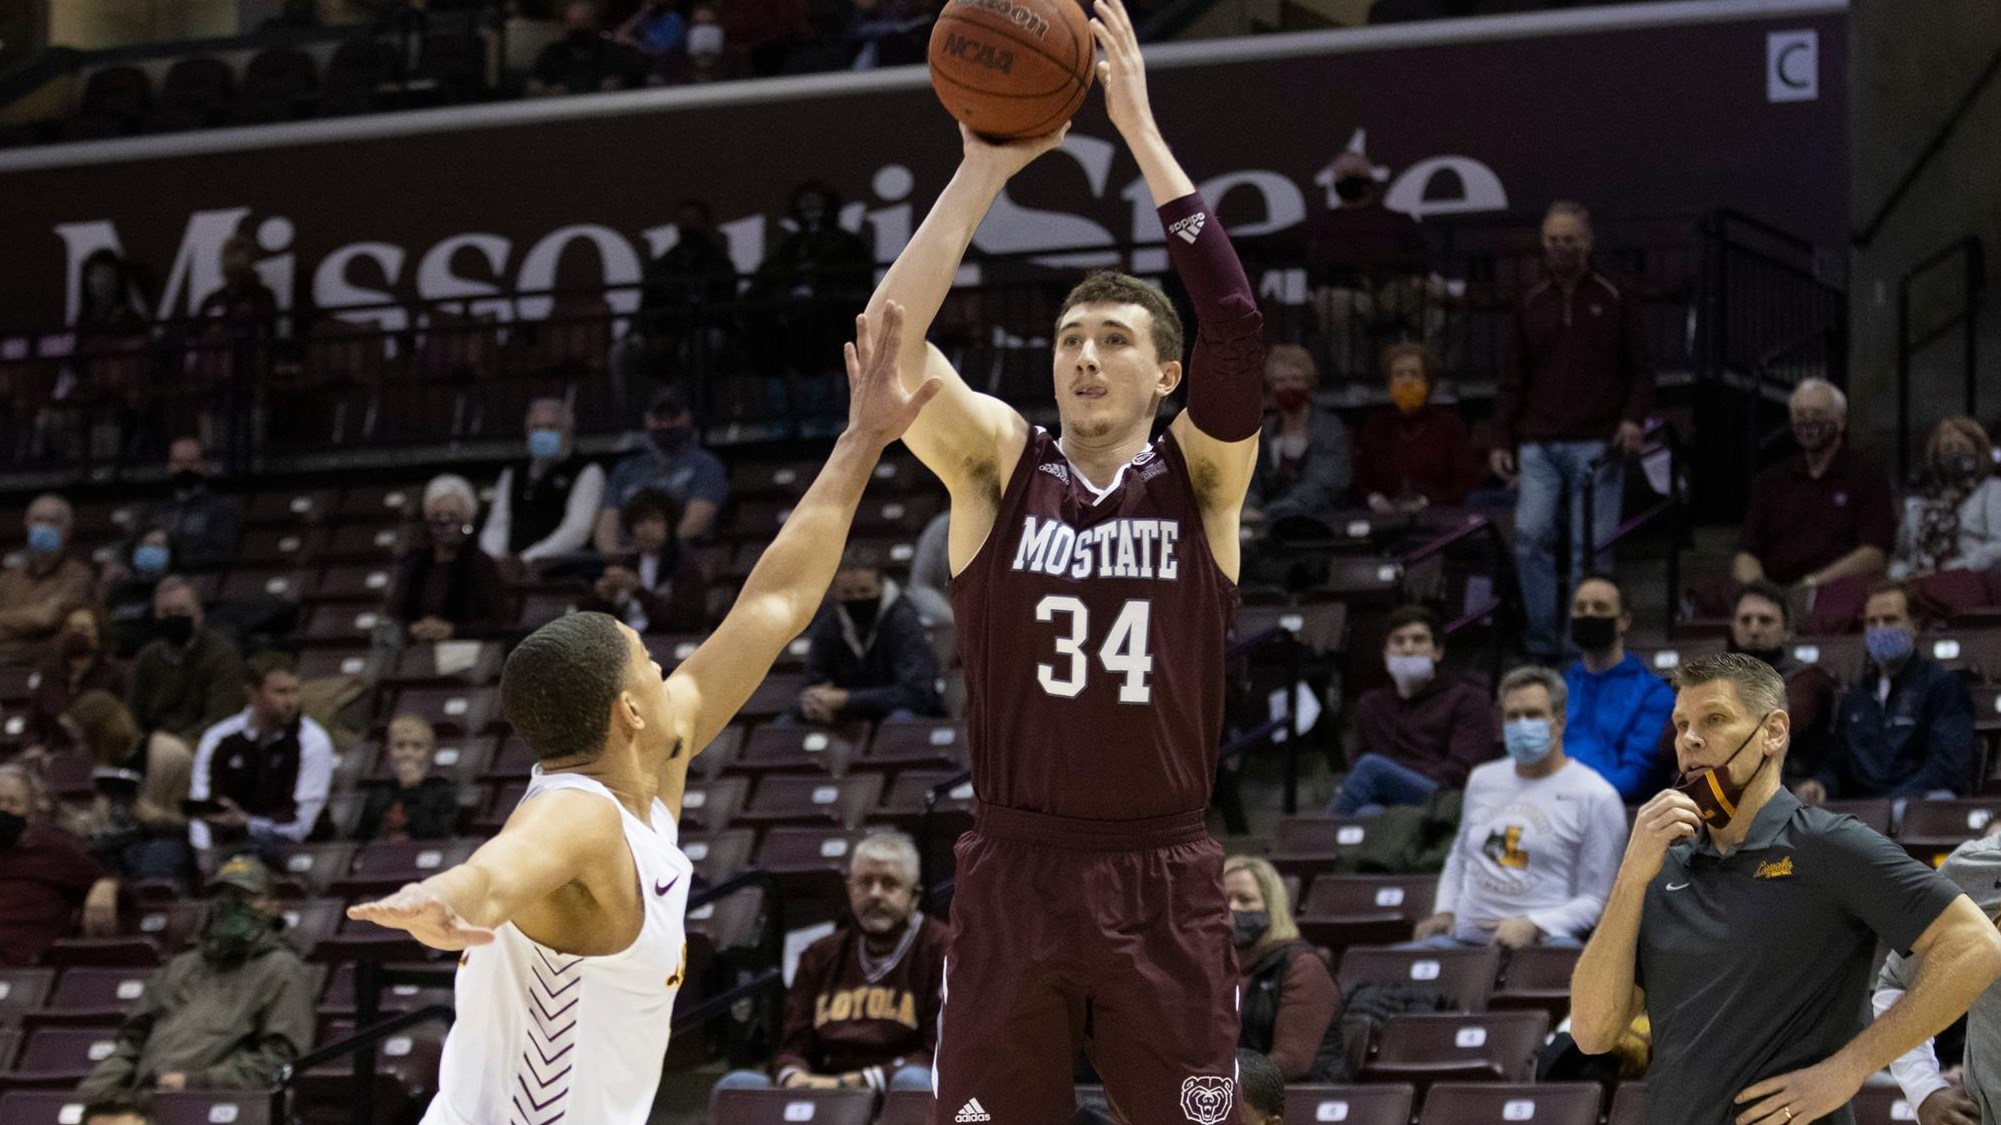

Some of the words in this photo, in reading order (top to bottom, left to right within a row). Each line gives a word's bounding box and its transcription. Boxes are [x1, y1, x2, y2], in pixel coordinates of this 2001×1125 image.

[943, 31, 1015, 75] NCAA
[1778, 42, 1809, 89] C
[1169, 212, 1205, 233] adidas
[1039, 464, 1070, 485] adidas
[1035, 595, 1153, 704] 34
[814, 987, 918, 1030] LOYOLA
